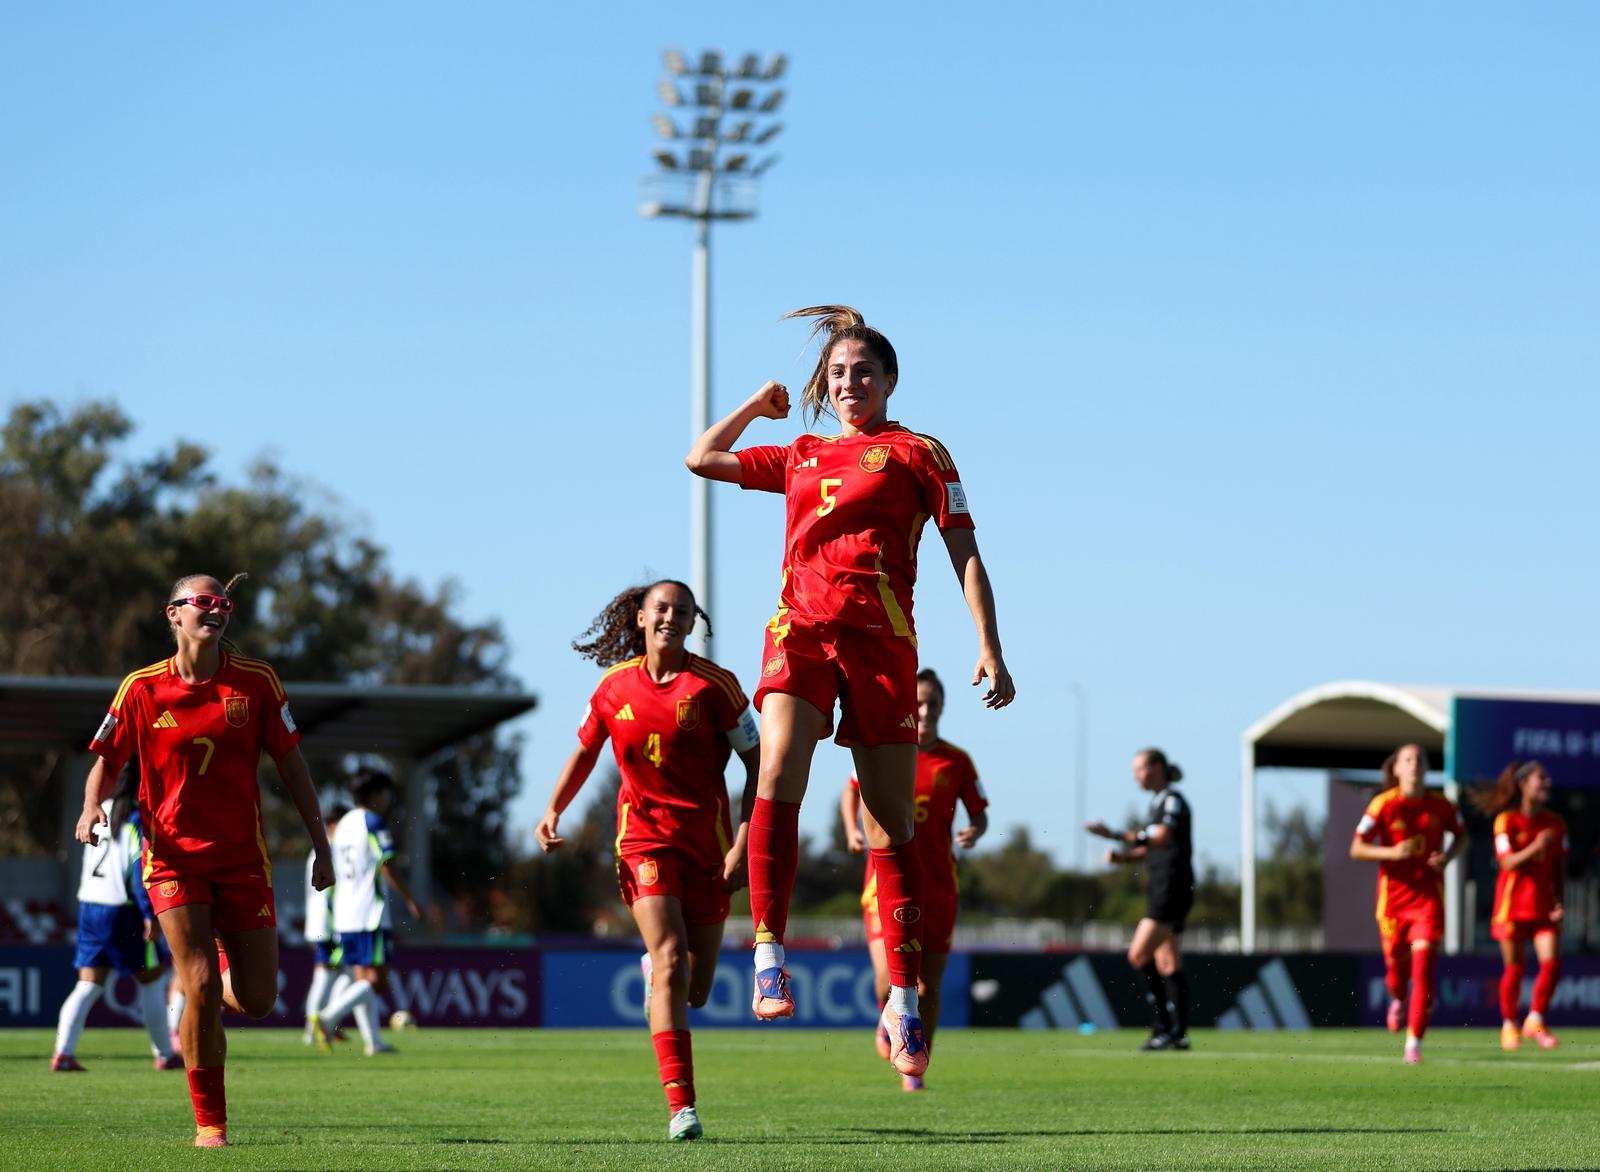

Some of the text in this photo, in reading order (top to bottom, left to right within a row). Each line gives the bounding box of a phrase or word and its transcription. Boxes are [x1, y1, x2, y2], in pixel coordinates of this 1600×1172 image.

[816, 478, 842, 517] 5
[193, 737, 215, 776] 7
[643, 733, 662, 768] 4
[92, 837, 111, 878] 2
[373, 968, 529, 1018] WAYS
